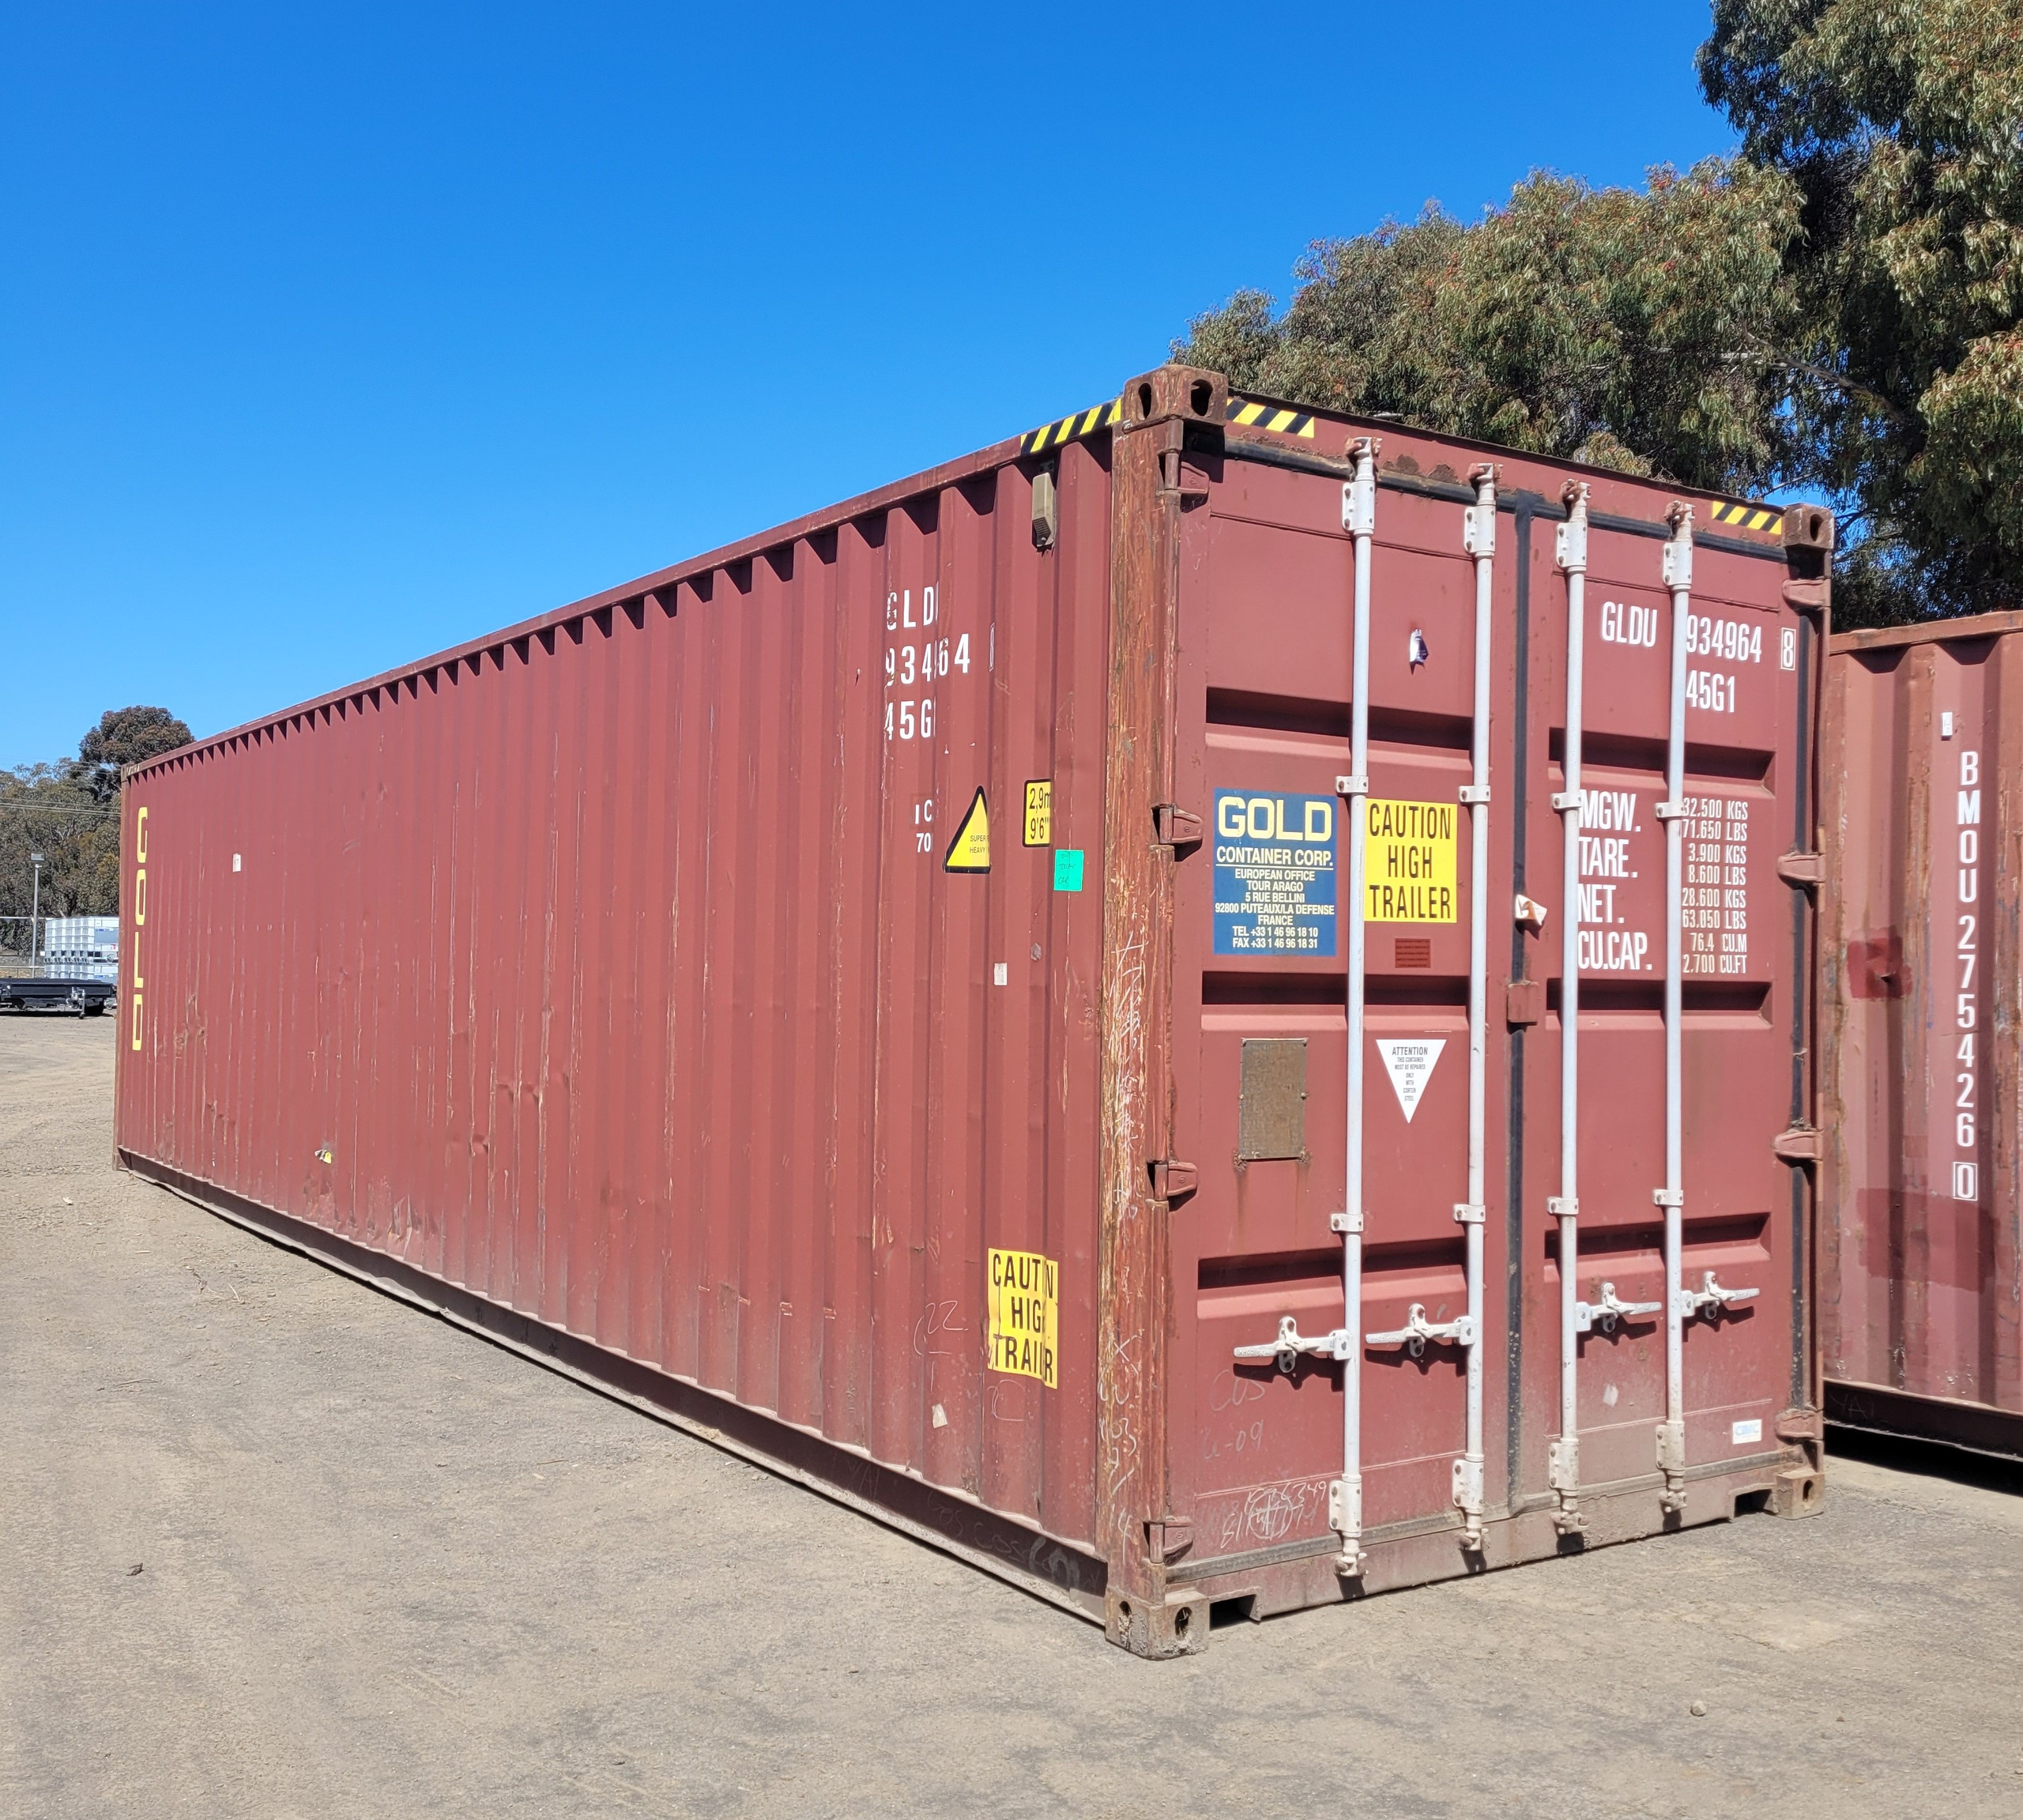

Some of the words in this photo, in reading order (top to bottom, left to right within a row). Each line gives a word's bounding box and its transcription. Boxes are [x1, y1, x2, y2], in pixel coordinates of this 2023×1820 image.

[887, 581, 939, 631] GLD
[1601, 601, 1658, 647] GLDU
[1686, 615, 1762, 663] 934964
[1782, 629, 1795, 669] 8
[885, 634, 970, 687] 93464
[1686, 670, 1736, 713] 45G1
[883, 695, 936, 740] 45G
[1218, 796, 1332, 842] GOLD
[1369, 803, 1452, 840] CAUTION
[1579, 789, 1641, 832] MGW.
[1683, 797, 1722, 819] 32,500
[1727, 800, 1748, 820] KGS
[1957, 751, 1980, 903] BMOU
[916, 832, 932, 853] 70
[1682, 819, 1721, 840] 71,650
[1726, 822, 1747, 842] LBS
[1216, 846, 1292, 865] CONTAINER
[1294, 850, 1333, 866] CORP.
[1388, 845, 1433, 879] HIGH
[1579, 836, 1638, 878] TARE.
[1689, 842, 1720, 863] 3,900
[1724, 844, 1746, 865] KGS
[1234, 868, 1283, 880] EUROPEAN
[1284, 870, 1316, 881] OFFICE
[1246, 880, 1271, 891] TOUR
[1272, 881, 1304, 892] ARAGO
[1689, 865, 1720, 884] 8,600
[1724, 866, 1746, 886] LBS
[1215, 902, 1239, 913] 92800
[1241, 902, 1294, 914] PUTEAUX/LA
[1296, 905, 1335, 915] DEFENSE
[1245, 892, 1251, 902] 5
[1252, 892, 1271, 902] RUE
[1272, 893, 1305, 902] BELLINI
[1369, 885, 1451, 919] TRAILER
[1578, 884, 1625, 923] NET.
[1682, 887, 1720, 907] 28,600
[1724, 889, 1746, 909] KGS
[1232, 925, 1249, 936] TEL
[1250, 927, 1266, 936] +33
[1268, 927, 1272, 936] 1
[1274, 927, 1284, 937] 46
[1286, 927, 1296, 937] 96
[1297, 927, 1307, 937] 18
[1308, 927, 1319, 937] 10
[1258, 915, 1294, 925] FRANCE
[1682, 909, 1720, 929] 63,050
[1724, 910, 1746, 930] LBS
[1232, 937, 1250, 948] FAX
[1250, 938, 1266, 948] +33
[1268, 938, 1272, 948] 1
[1274, 938, 1284, 948] 46
[1286, 938, 1296, 948] 96
[1297, 938, 1307, 948] 18
[1308, 938, 1318, 948] 31
[1578, 931, 1652, 970] CU.CAP.
[1690, 932, 1715, 952] 76.4
[1722, 933, 1747, 953] CU.M
[1682, 954, 1716, 974] 2,700
[1720, 955, 1747, 974] CU.FT
[1957, 915, 1976, 1147] 275426
[1392, 1046, 1428, 1056] ATTENTION
[993, 1253, 1053, 1299] CAUTN
[1011, 1296, 1045, 1334] HIG
[993, 1333, 1053, 1384] TRAILR
